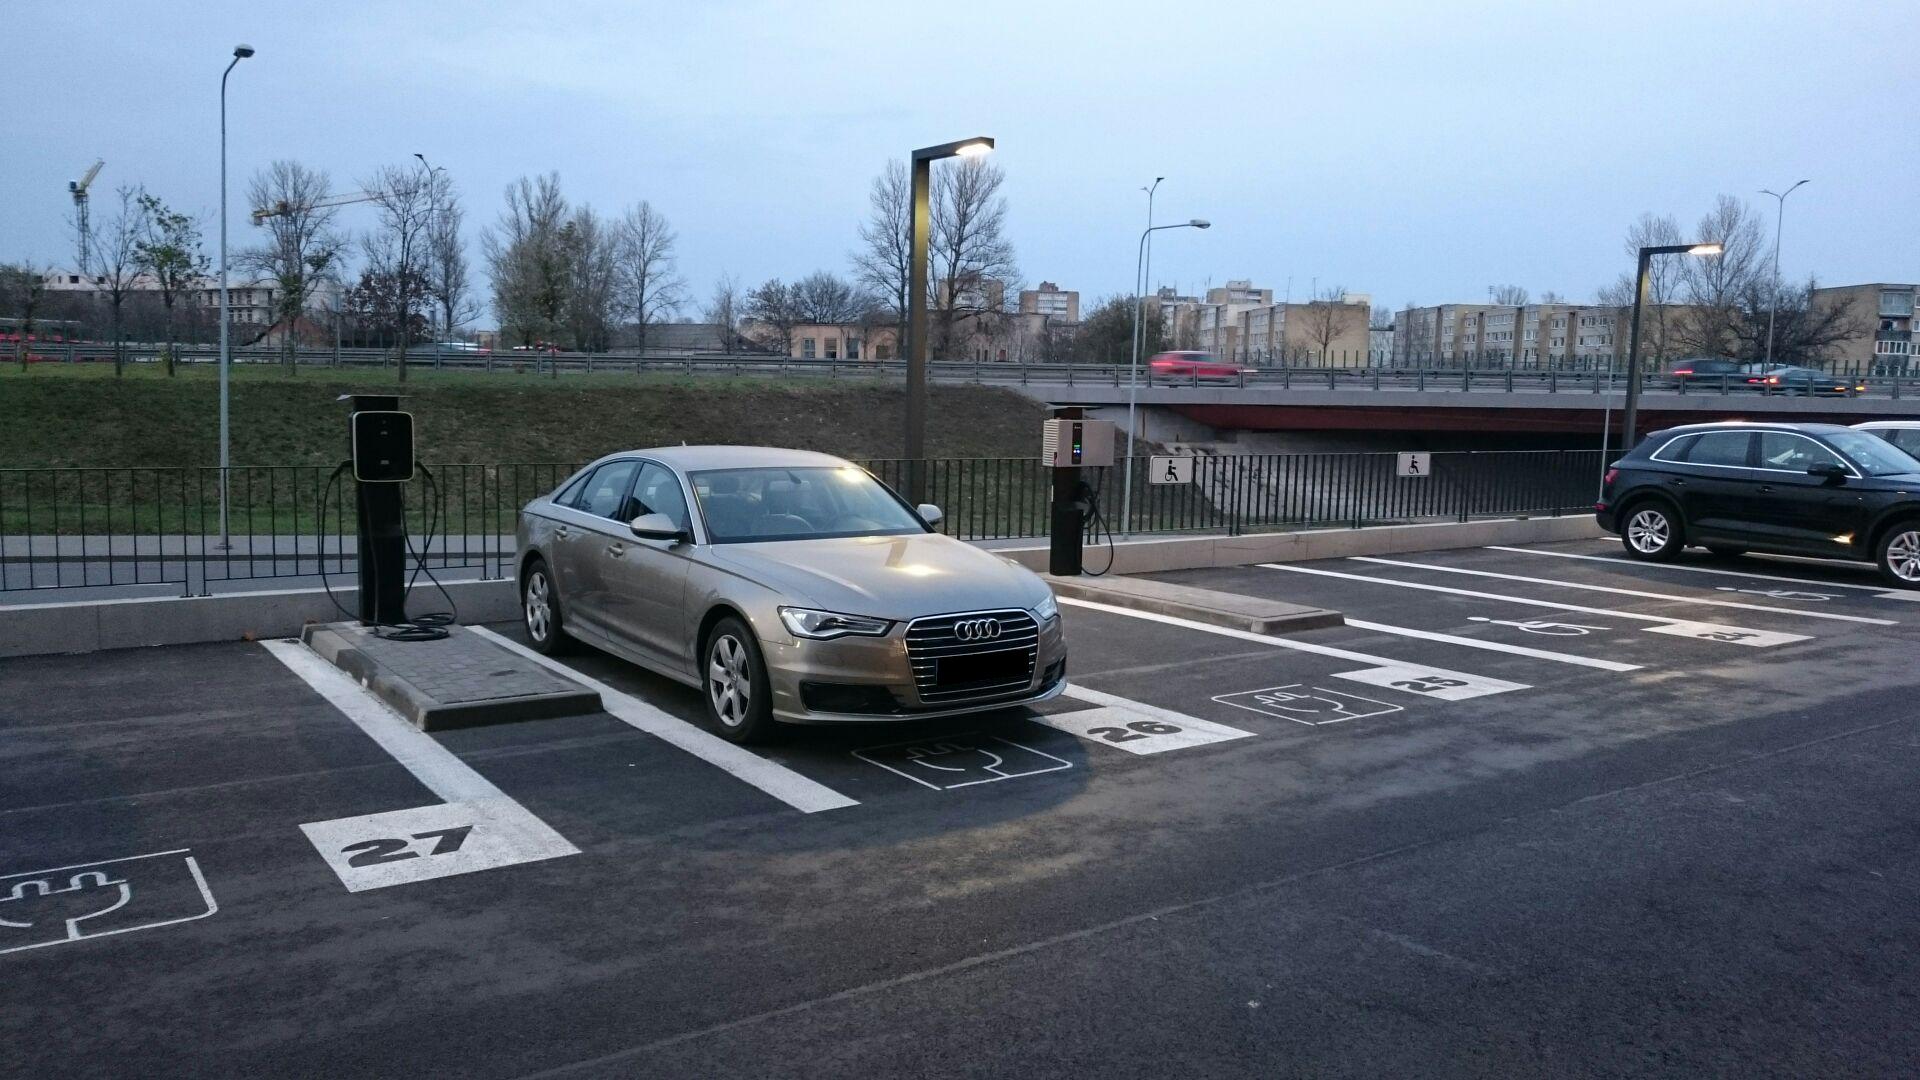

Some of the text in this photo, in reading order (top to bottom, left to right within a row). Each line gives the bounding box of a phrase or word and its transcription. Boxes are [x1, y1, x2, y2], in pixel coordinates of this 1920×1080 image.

[1390, 676, 1469, 692] 25
[1087, 721, 1183, 743] 26
[340, 825, 473, 868] 27
